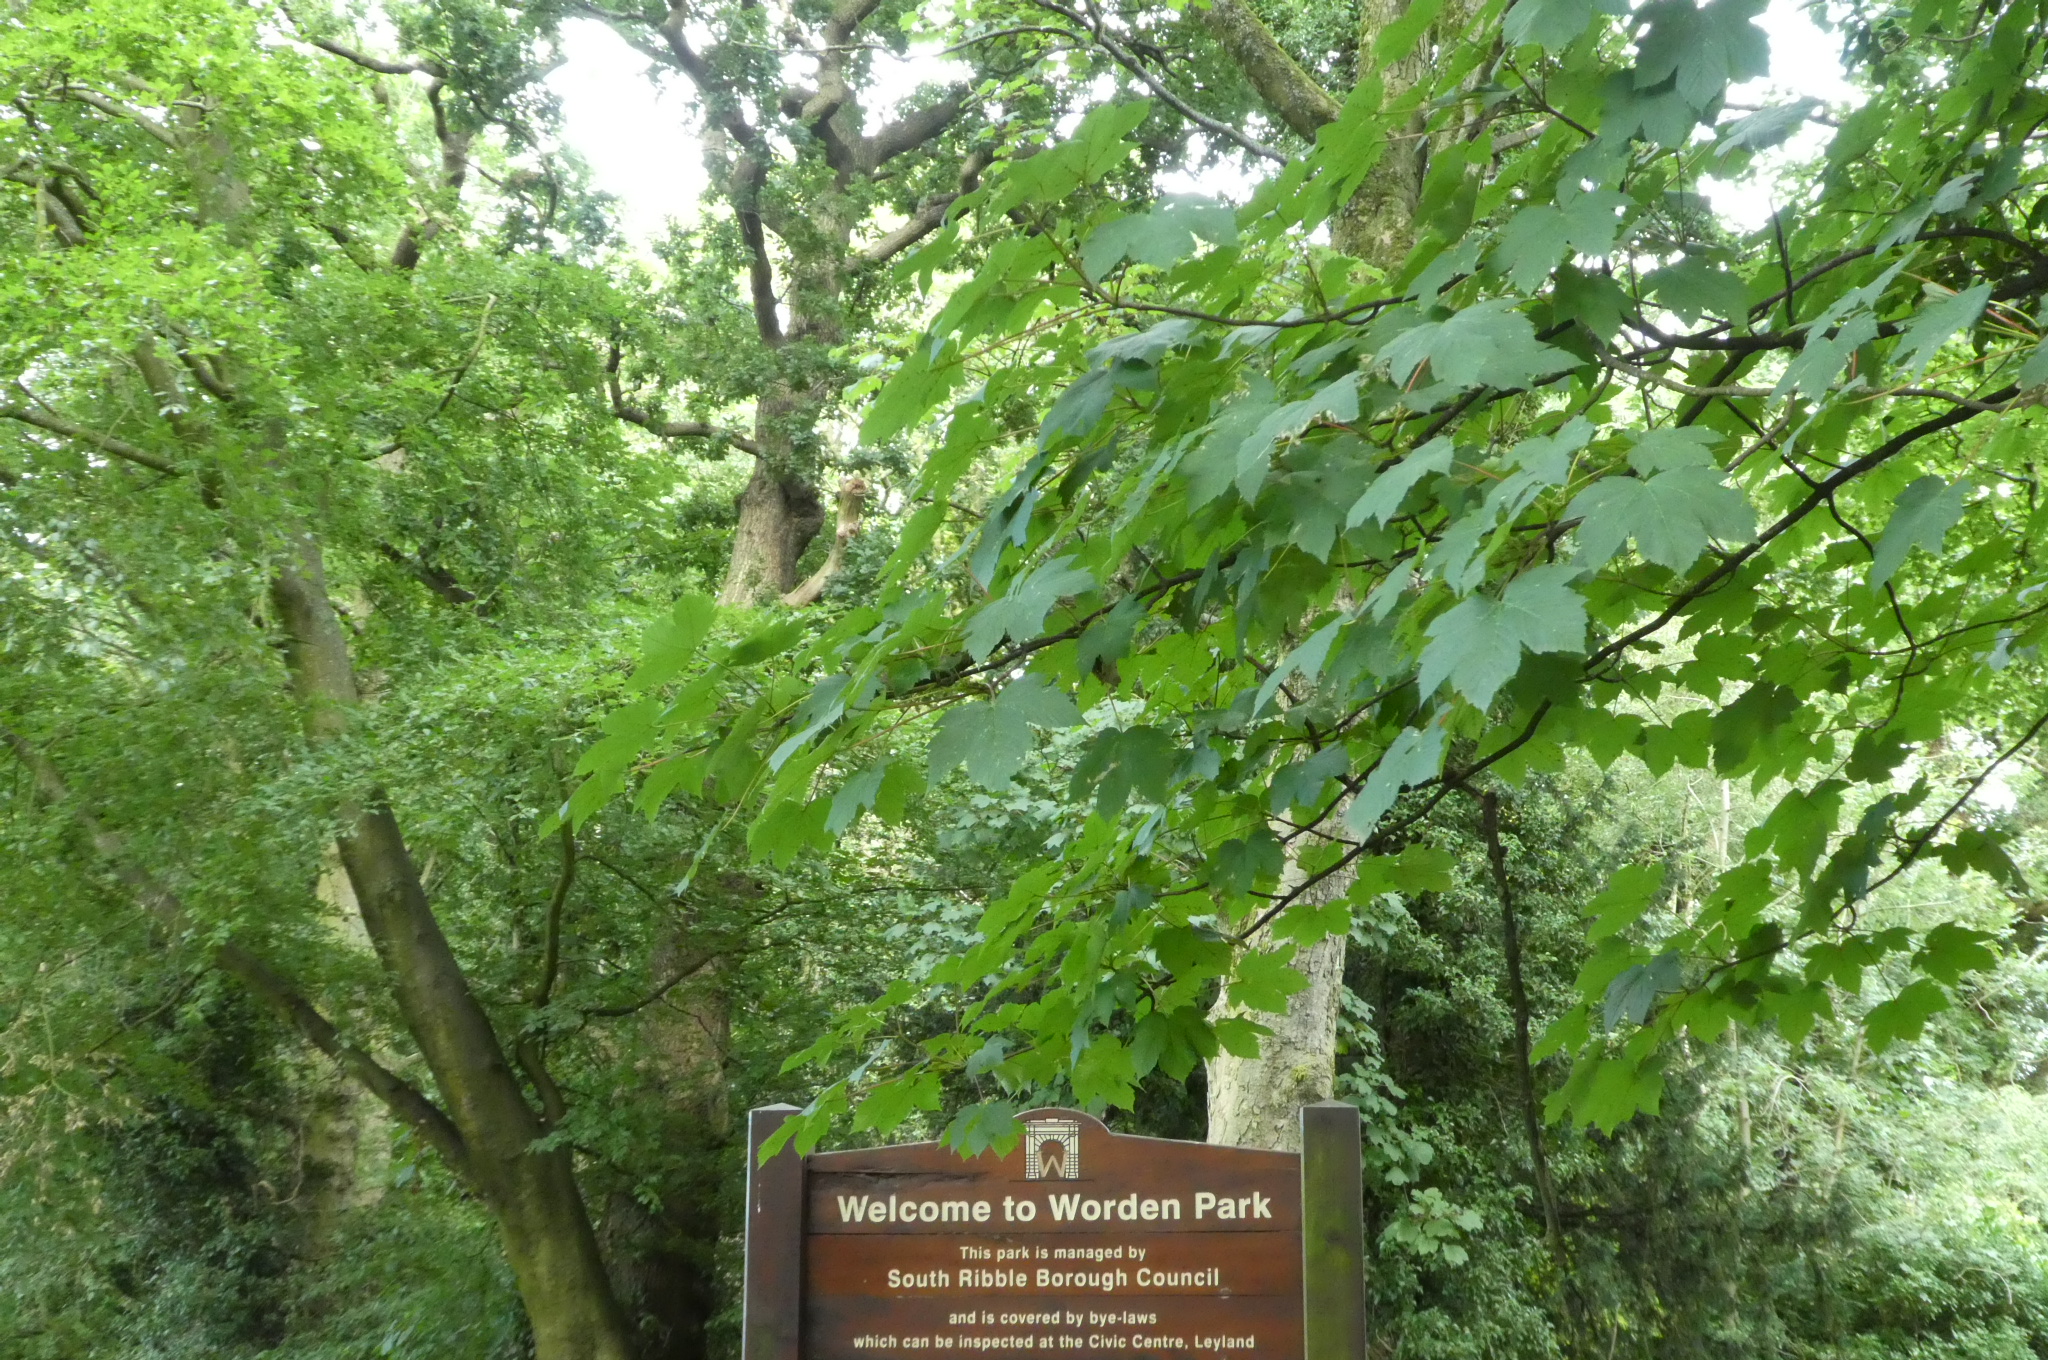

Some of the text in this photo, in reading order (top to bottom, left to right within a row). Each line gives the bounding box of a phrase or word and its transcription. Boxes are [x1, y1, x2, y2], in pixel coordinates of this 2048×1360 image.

[1037, 1151, 1068, 1177] W
[837, 1191, 1272, 1223] Welcome to Worden Park
[959, 1245, 1146, 1263] This park is managed by
[887, 1267, 1219, 1292] South Ribble Borough Council
[948, 1310, 1157, 1328] and is covered by bye-laws
[853, 1333, 1255, 1352] which can be inspected at the Civic Centre, Leyland
